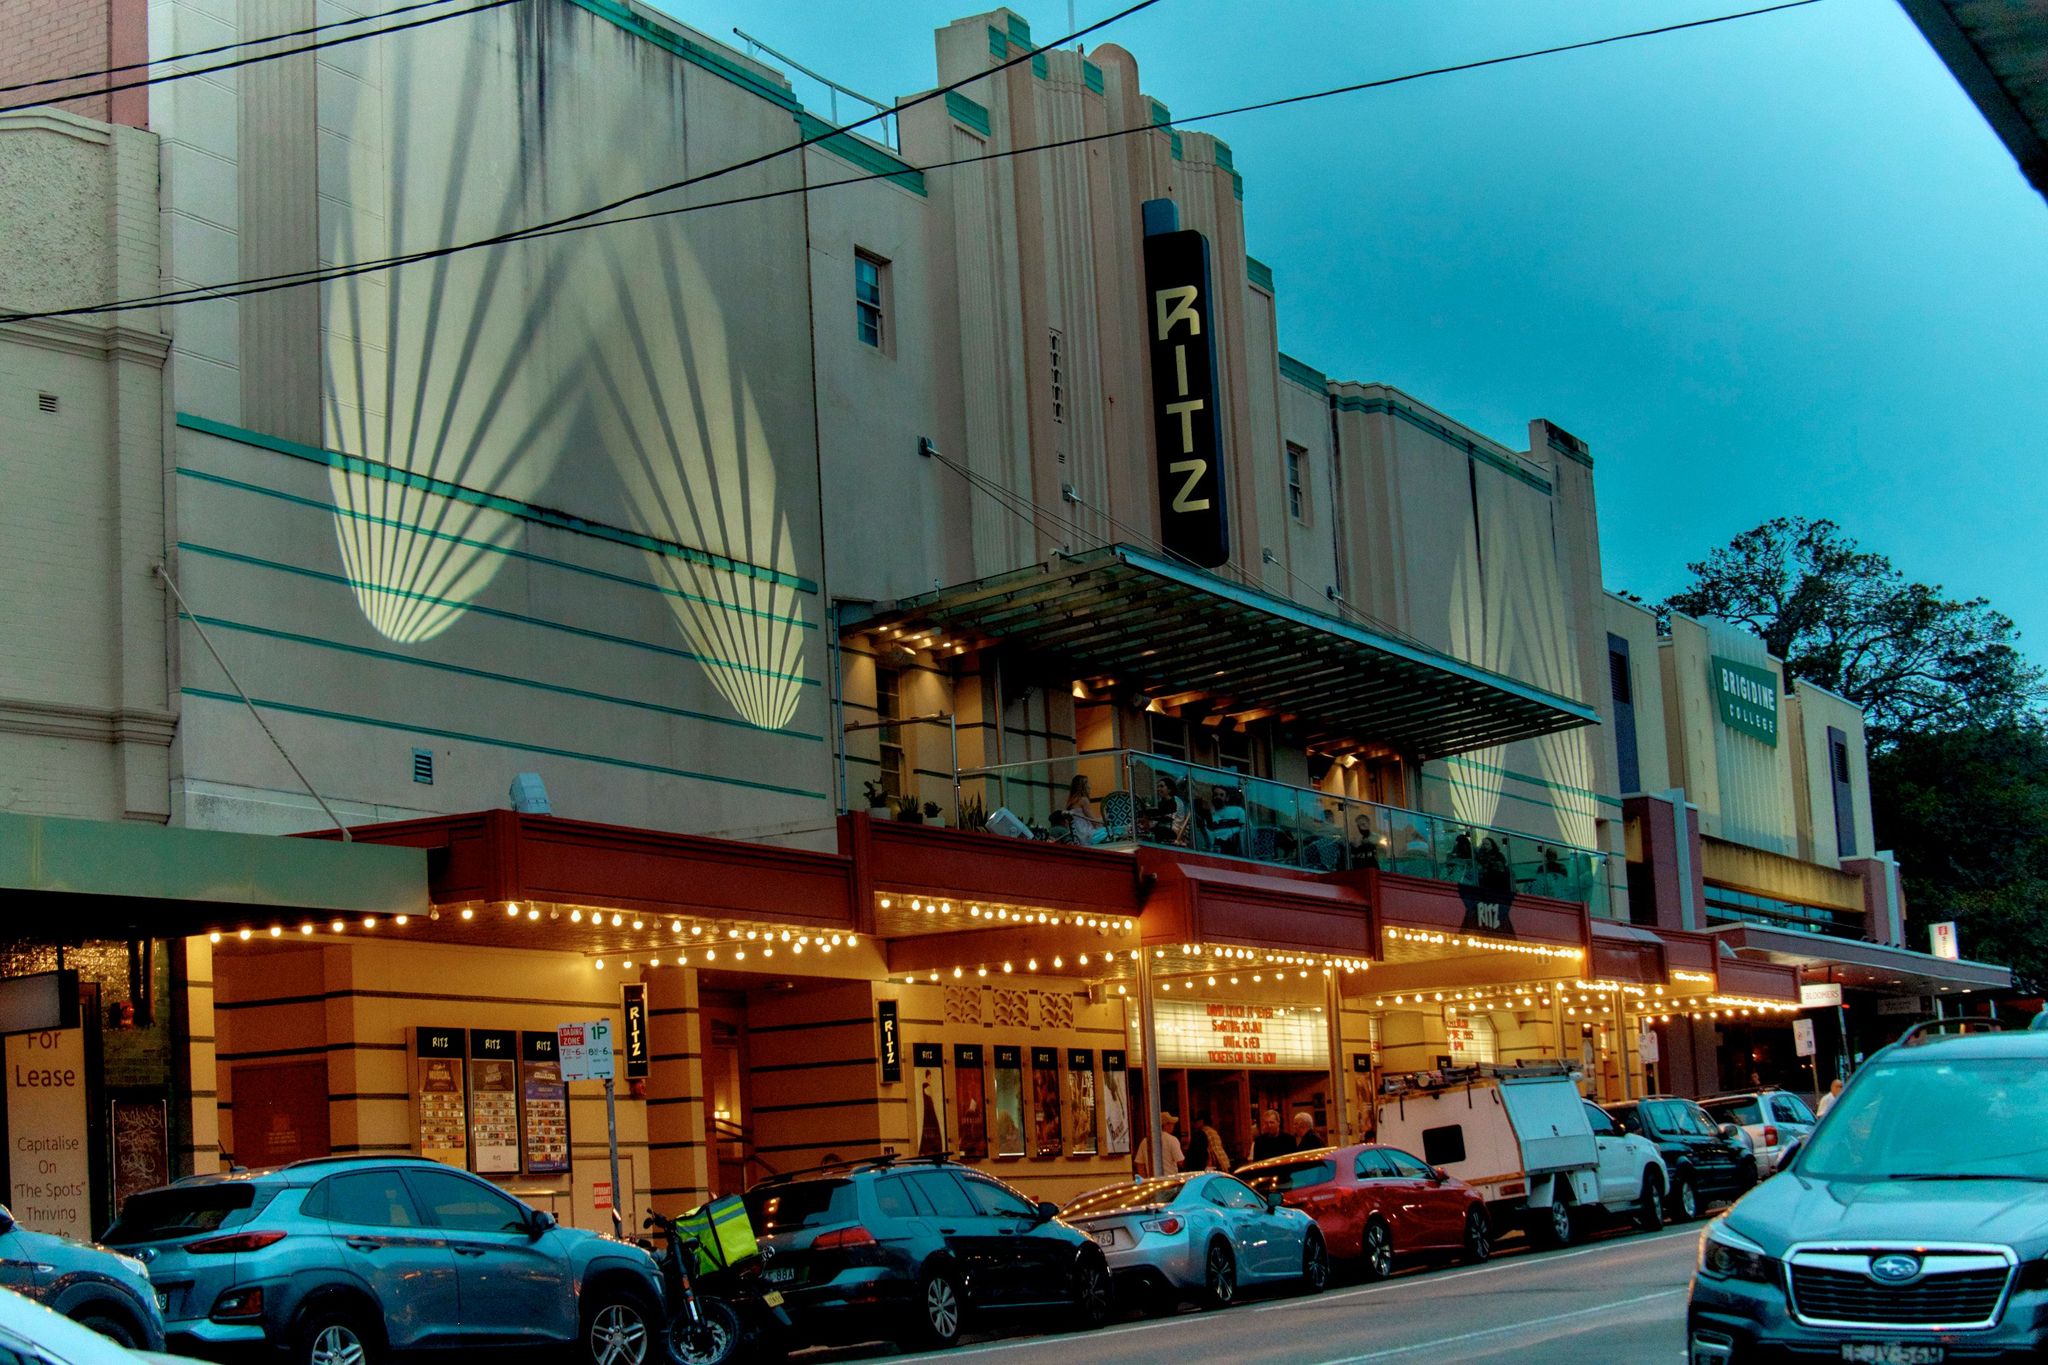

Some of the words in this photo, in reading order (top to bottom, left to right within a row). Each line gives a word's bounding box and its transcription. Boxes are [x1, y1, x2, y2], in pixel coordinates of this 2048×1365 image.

[1155, 284, 1210, 513] RITZ
[1721, 668, 1776, 711] BRIGIDINE
[1729, 704, 1774, 734] COLLEGE
[1477, 901, 1501, 930] RITZ
[27, 1030, 62, 1049] For
[563, 1037, 581, 1045] ZONE
[591, 1025, 608, 1040] 1P
[629, 1006, 641, 1057] RITZ
[432, 1036, 449, 1048] RITZ
[485, 1038, 501, 1050] RITZ
[536, 1040, 552, 1051] RITZ
[884, 1019, 896, 1065] RITZ
[15, 1064, 76, 1088] Lease
[17, 1135, 80, 1154] Capitalise
[38, 1159, 57, 1174] On
[26, 1205, 77, 1223] Thriving
